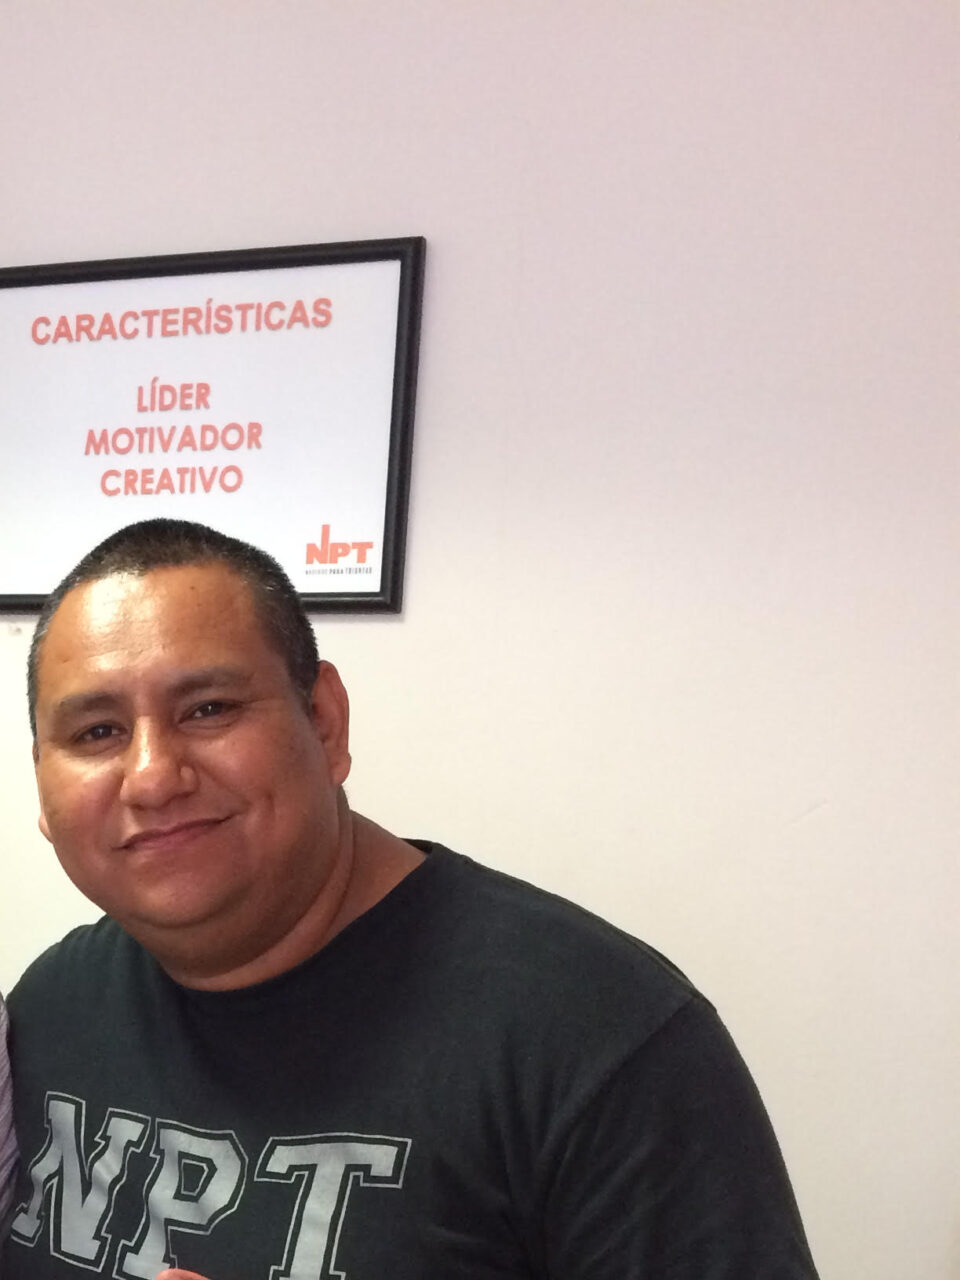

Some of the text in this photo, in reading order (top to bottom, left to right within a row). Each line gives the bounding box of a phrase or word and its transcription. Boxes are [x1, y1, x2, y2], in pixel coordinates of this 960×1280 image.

[31, 298, 333, 345] CARACTERÍSTICAS
[137, 377, 211, 413] LÍDER
[84, 421, 263, 456] MOTIVADOR
[100, 465, 244, 497] CREATIVO
[305, 524, 374, 565] NPT
